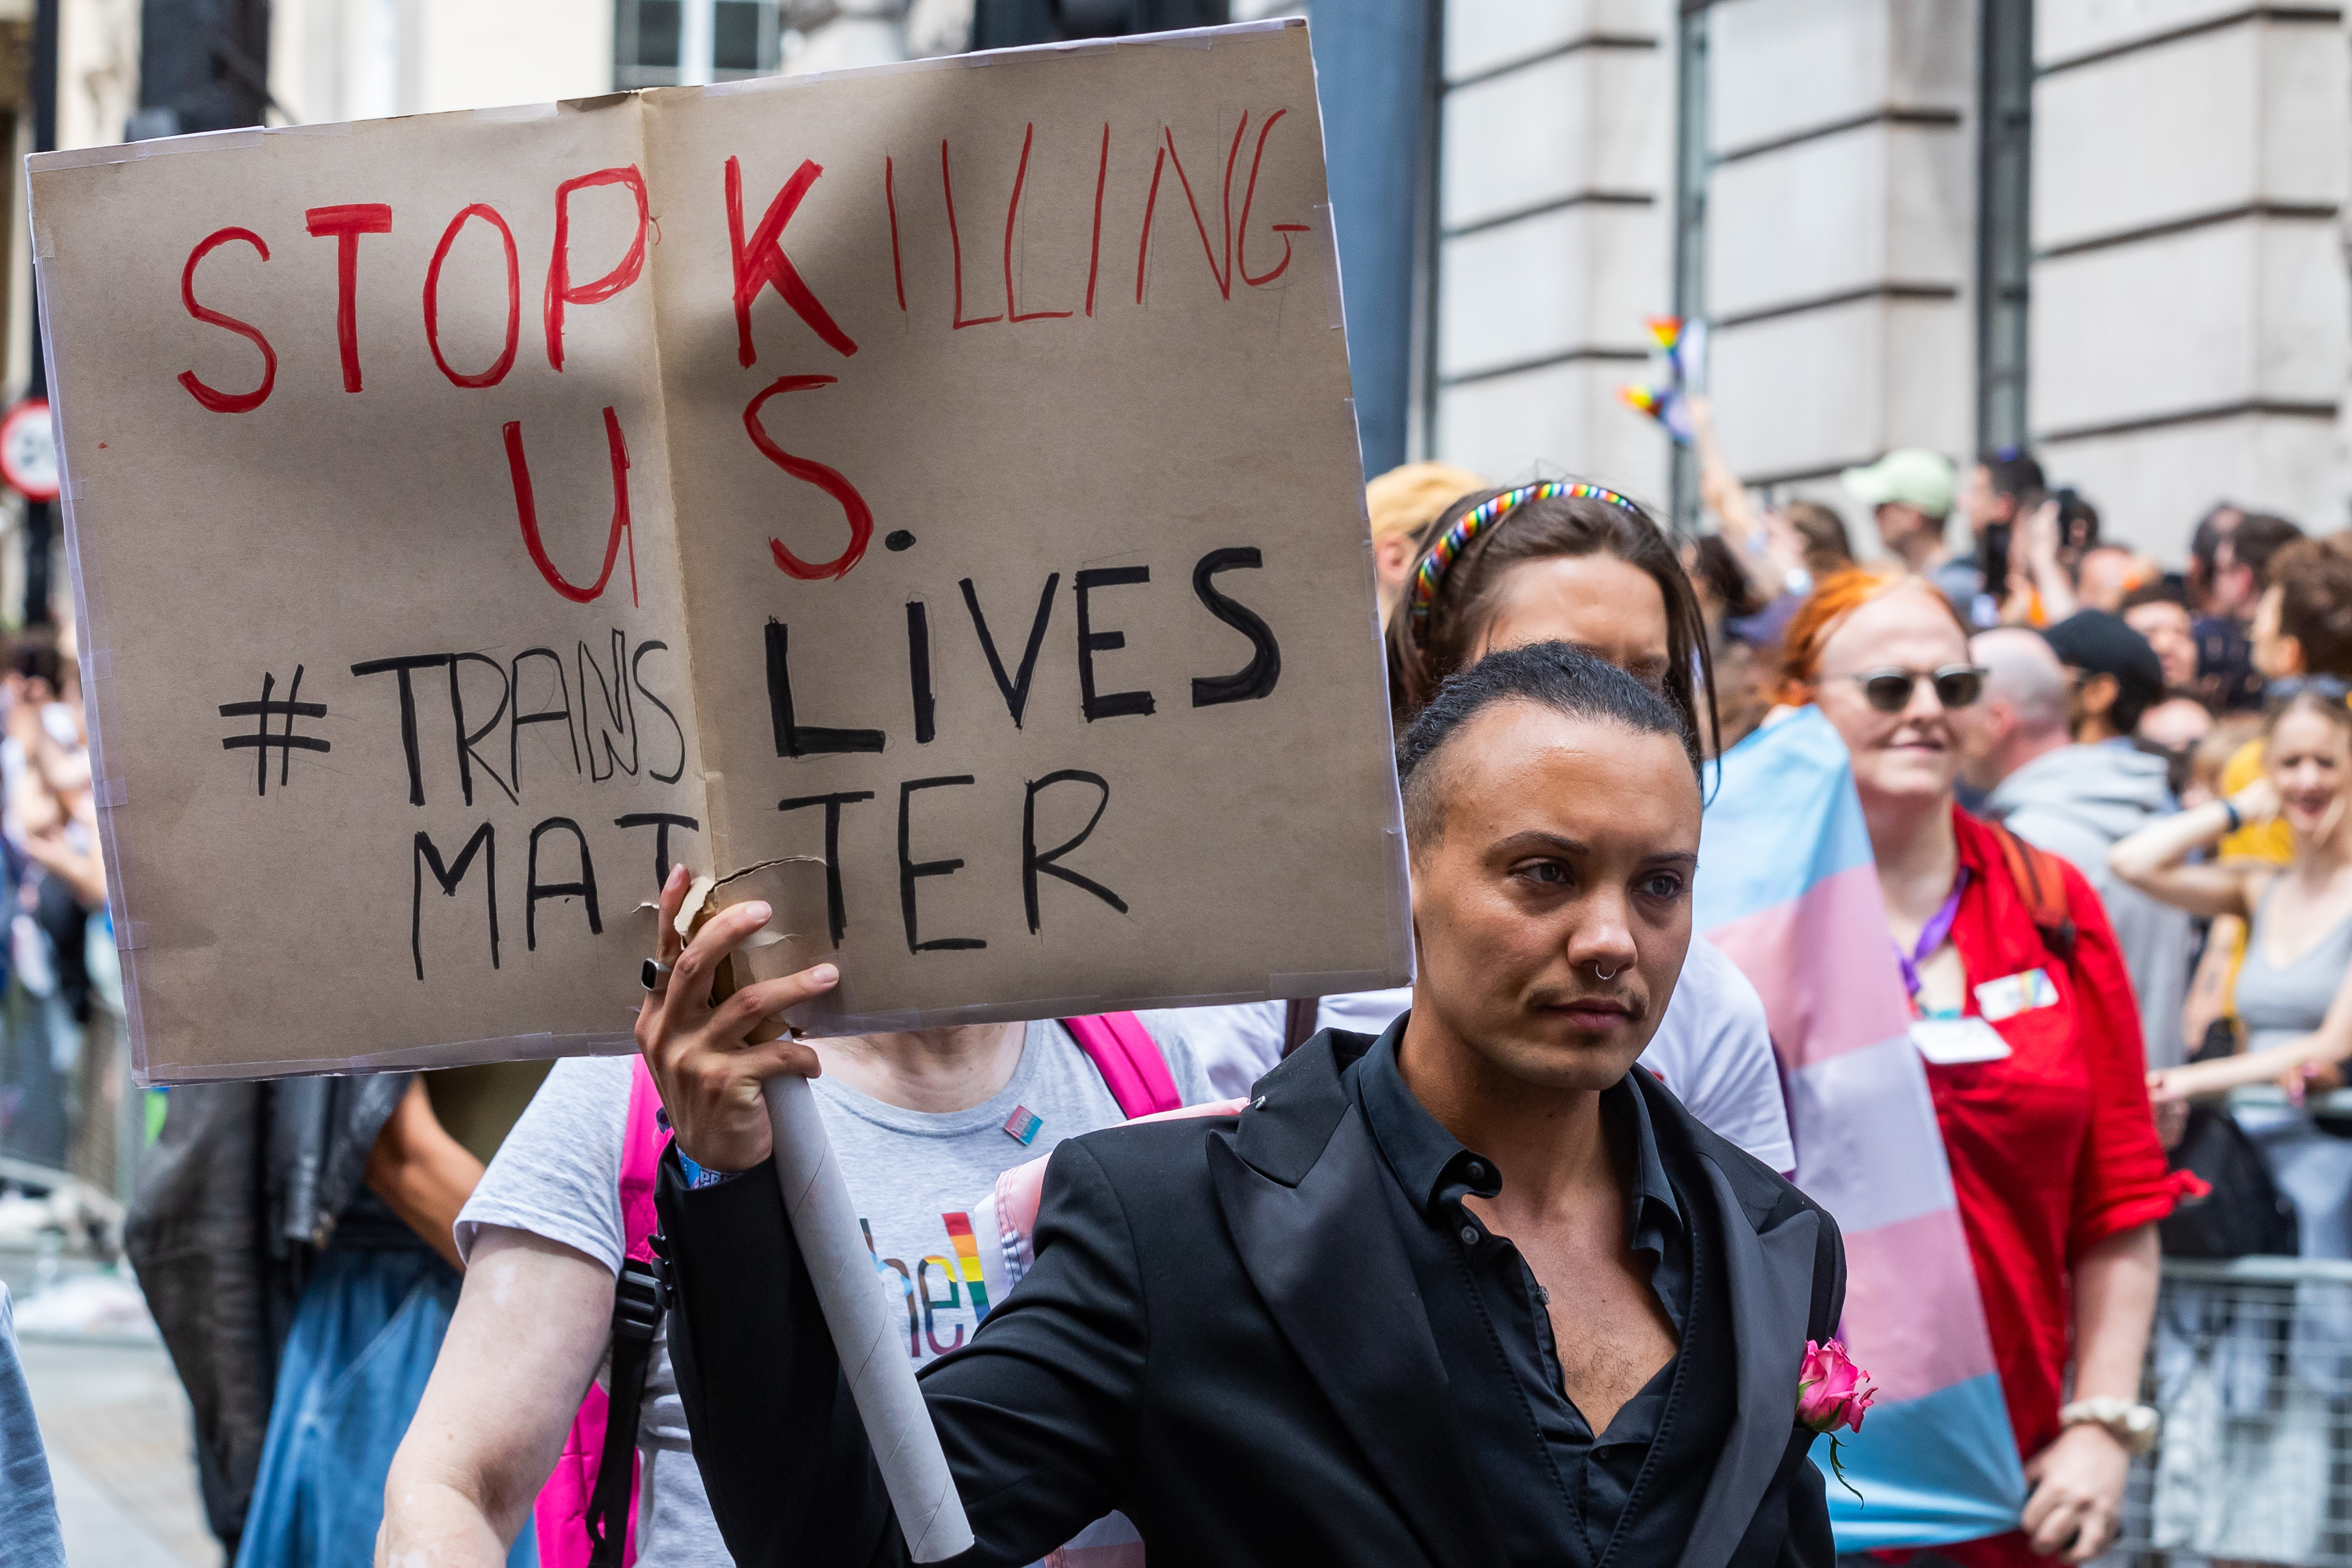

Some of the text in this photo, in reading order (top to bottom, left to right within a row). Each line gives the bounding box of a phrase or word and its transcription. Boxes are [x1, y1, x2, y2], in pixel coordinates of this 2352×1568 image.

[178, 109, 1310, 413] STOP KILLING
[764, 547, 1281, 759] LIVES
